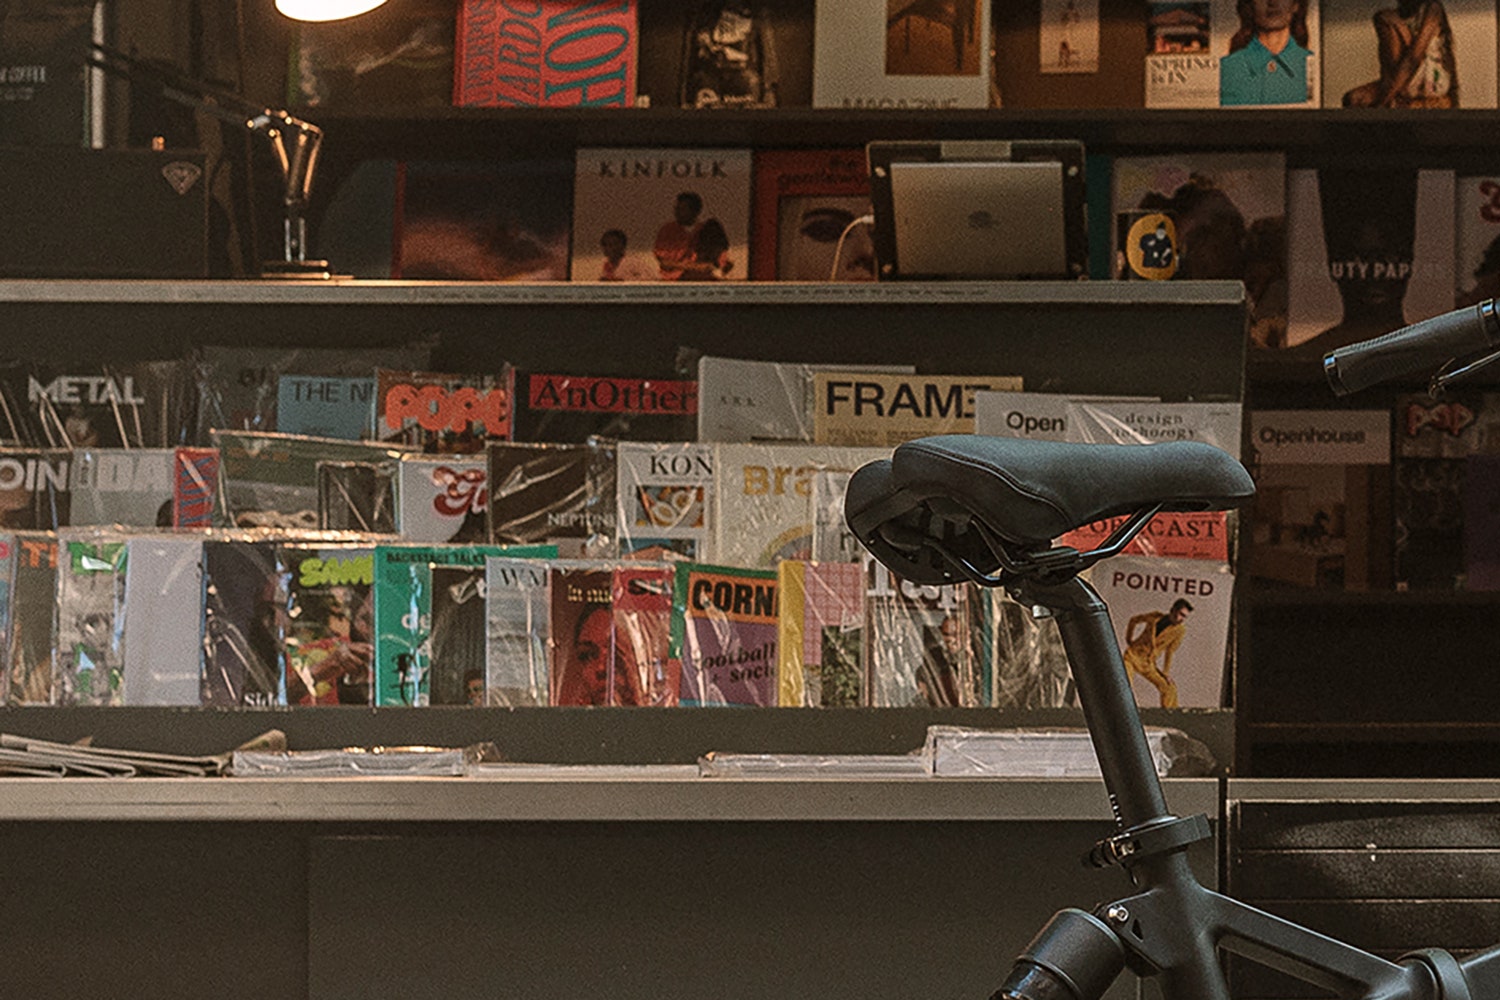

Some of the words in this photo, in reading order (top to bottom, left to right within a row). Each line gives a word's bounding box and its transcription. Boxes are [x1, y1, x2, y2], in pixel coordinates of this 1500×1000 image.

[600, 158, 729, 178] KINFOLK
[28, 374, 145, 405] METAL
[291, 381, 341, 403] THE
[534, 378, 698, 414] AnOther
[1112, 571, 1214, 596] POINTED
[703, 643, 775, 670] ootball
